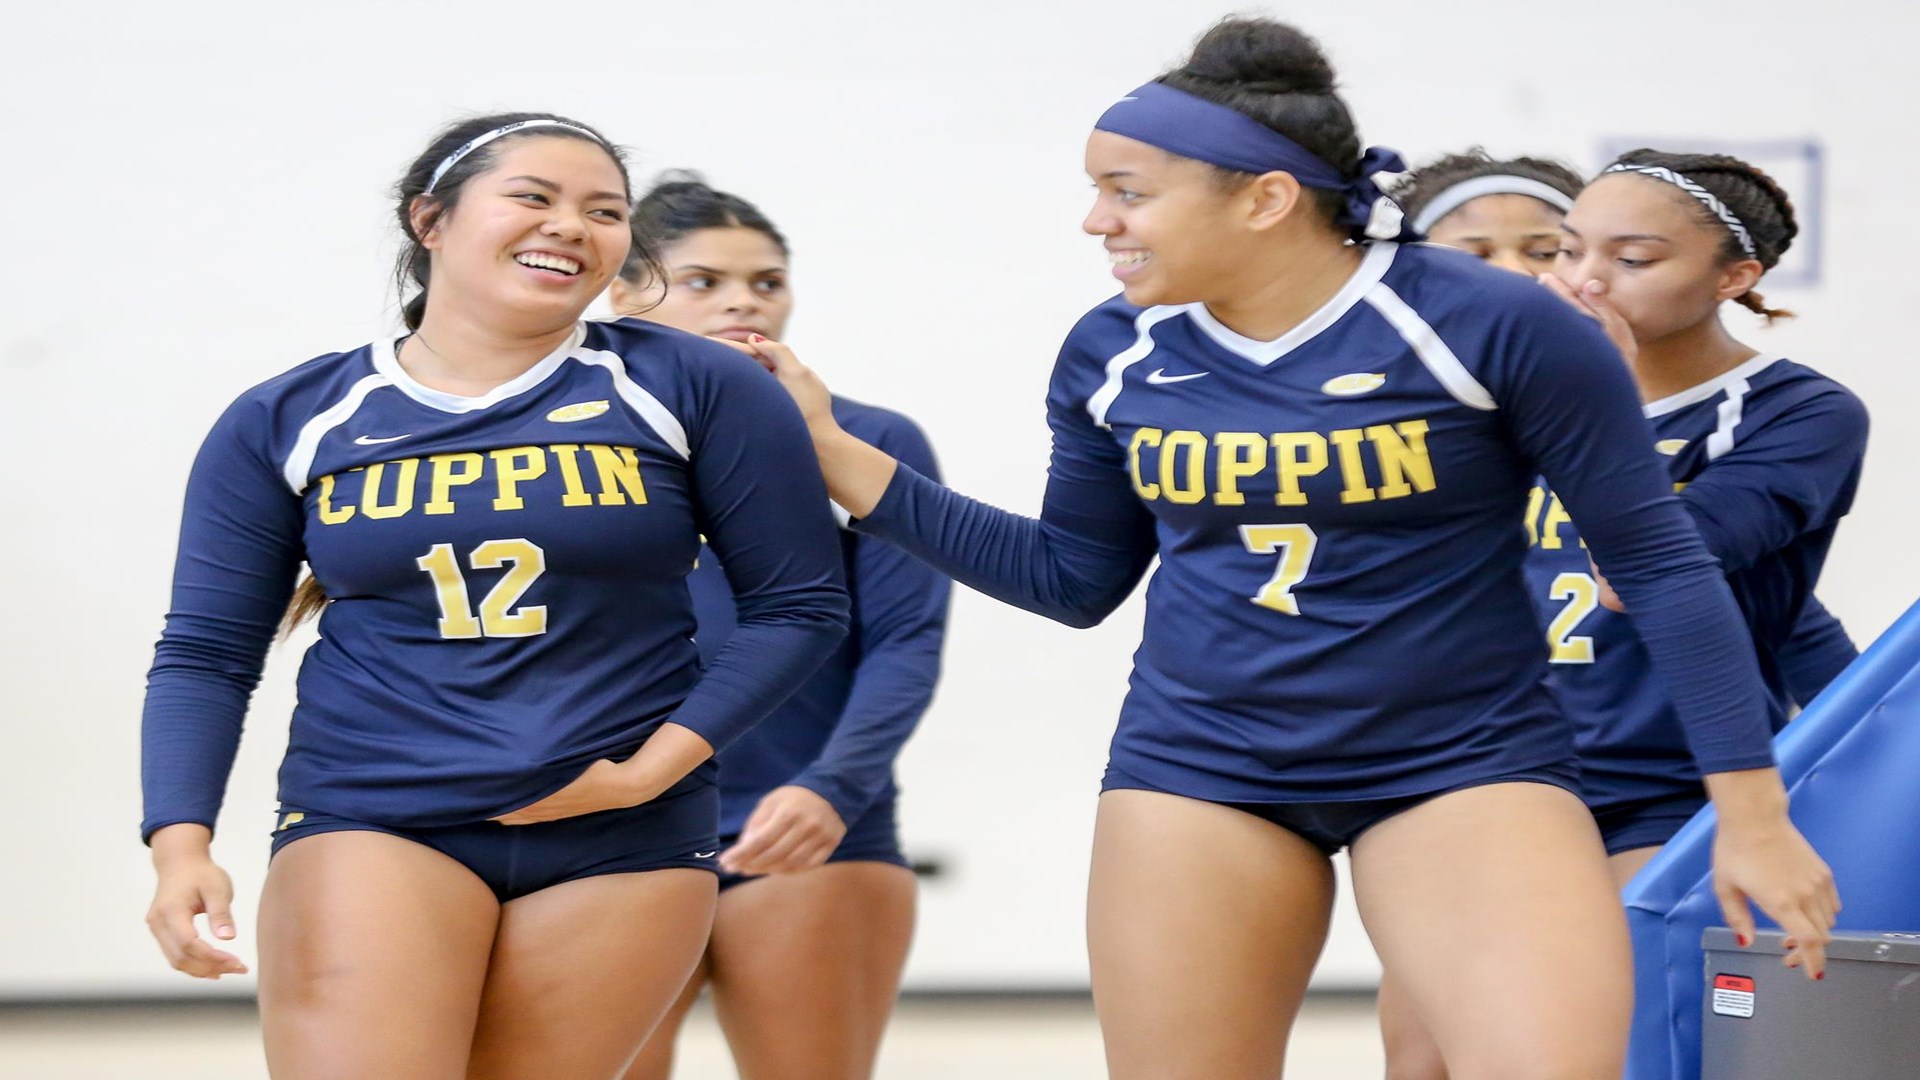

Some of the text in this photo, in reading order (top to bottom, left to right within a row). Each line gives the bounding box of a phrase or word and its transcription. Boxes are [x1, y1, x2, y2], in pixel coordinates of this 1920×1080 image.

[318, 444, 648, 525] COPPIN
[1129, 419, 1437, 506] COPPIN
[416, 538, 547, 639] 12
[1238, 523, 1318, 616] 7
[1547, 572, 1599, 664] 2
